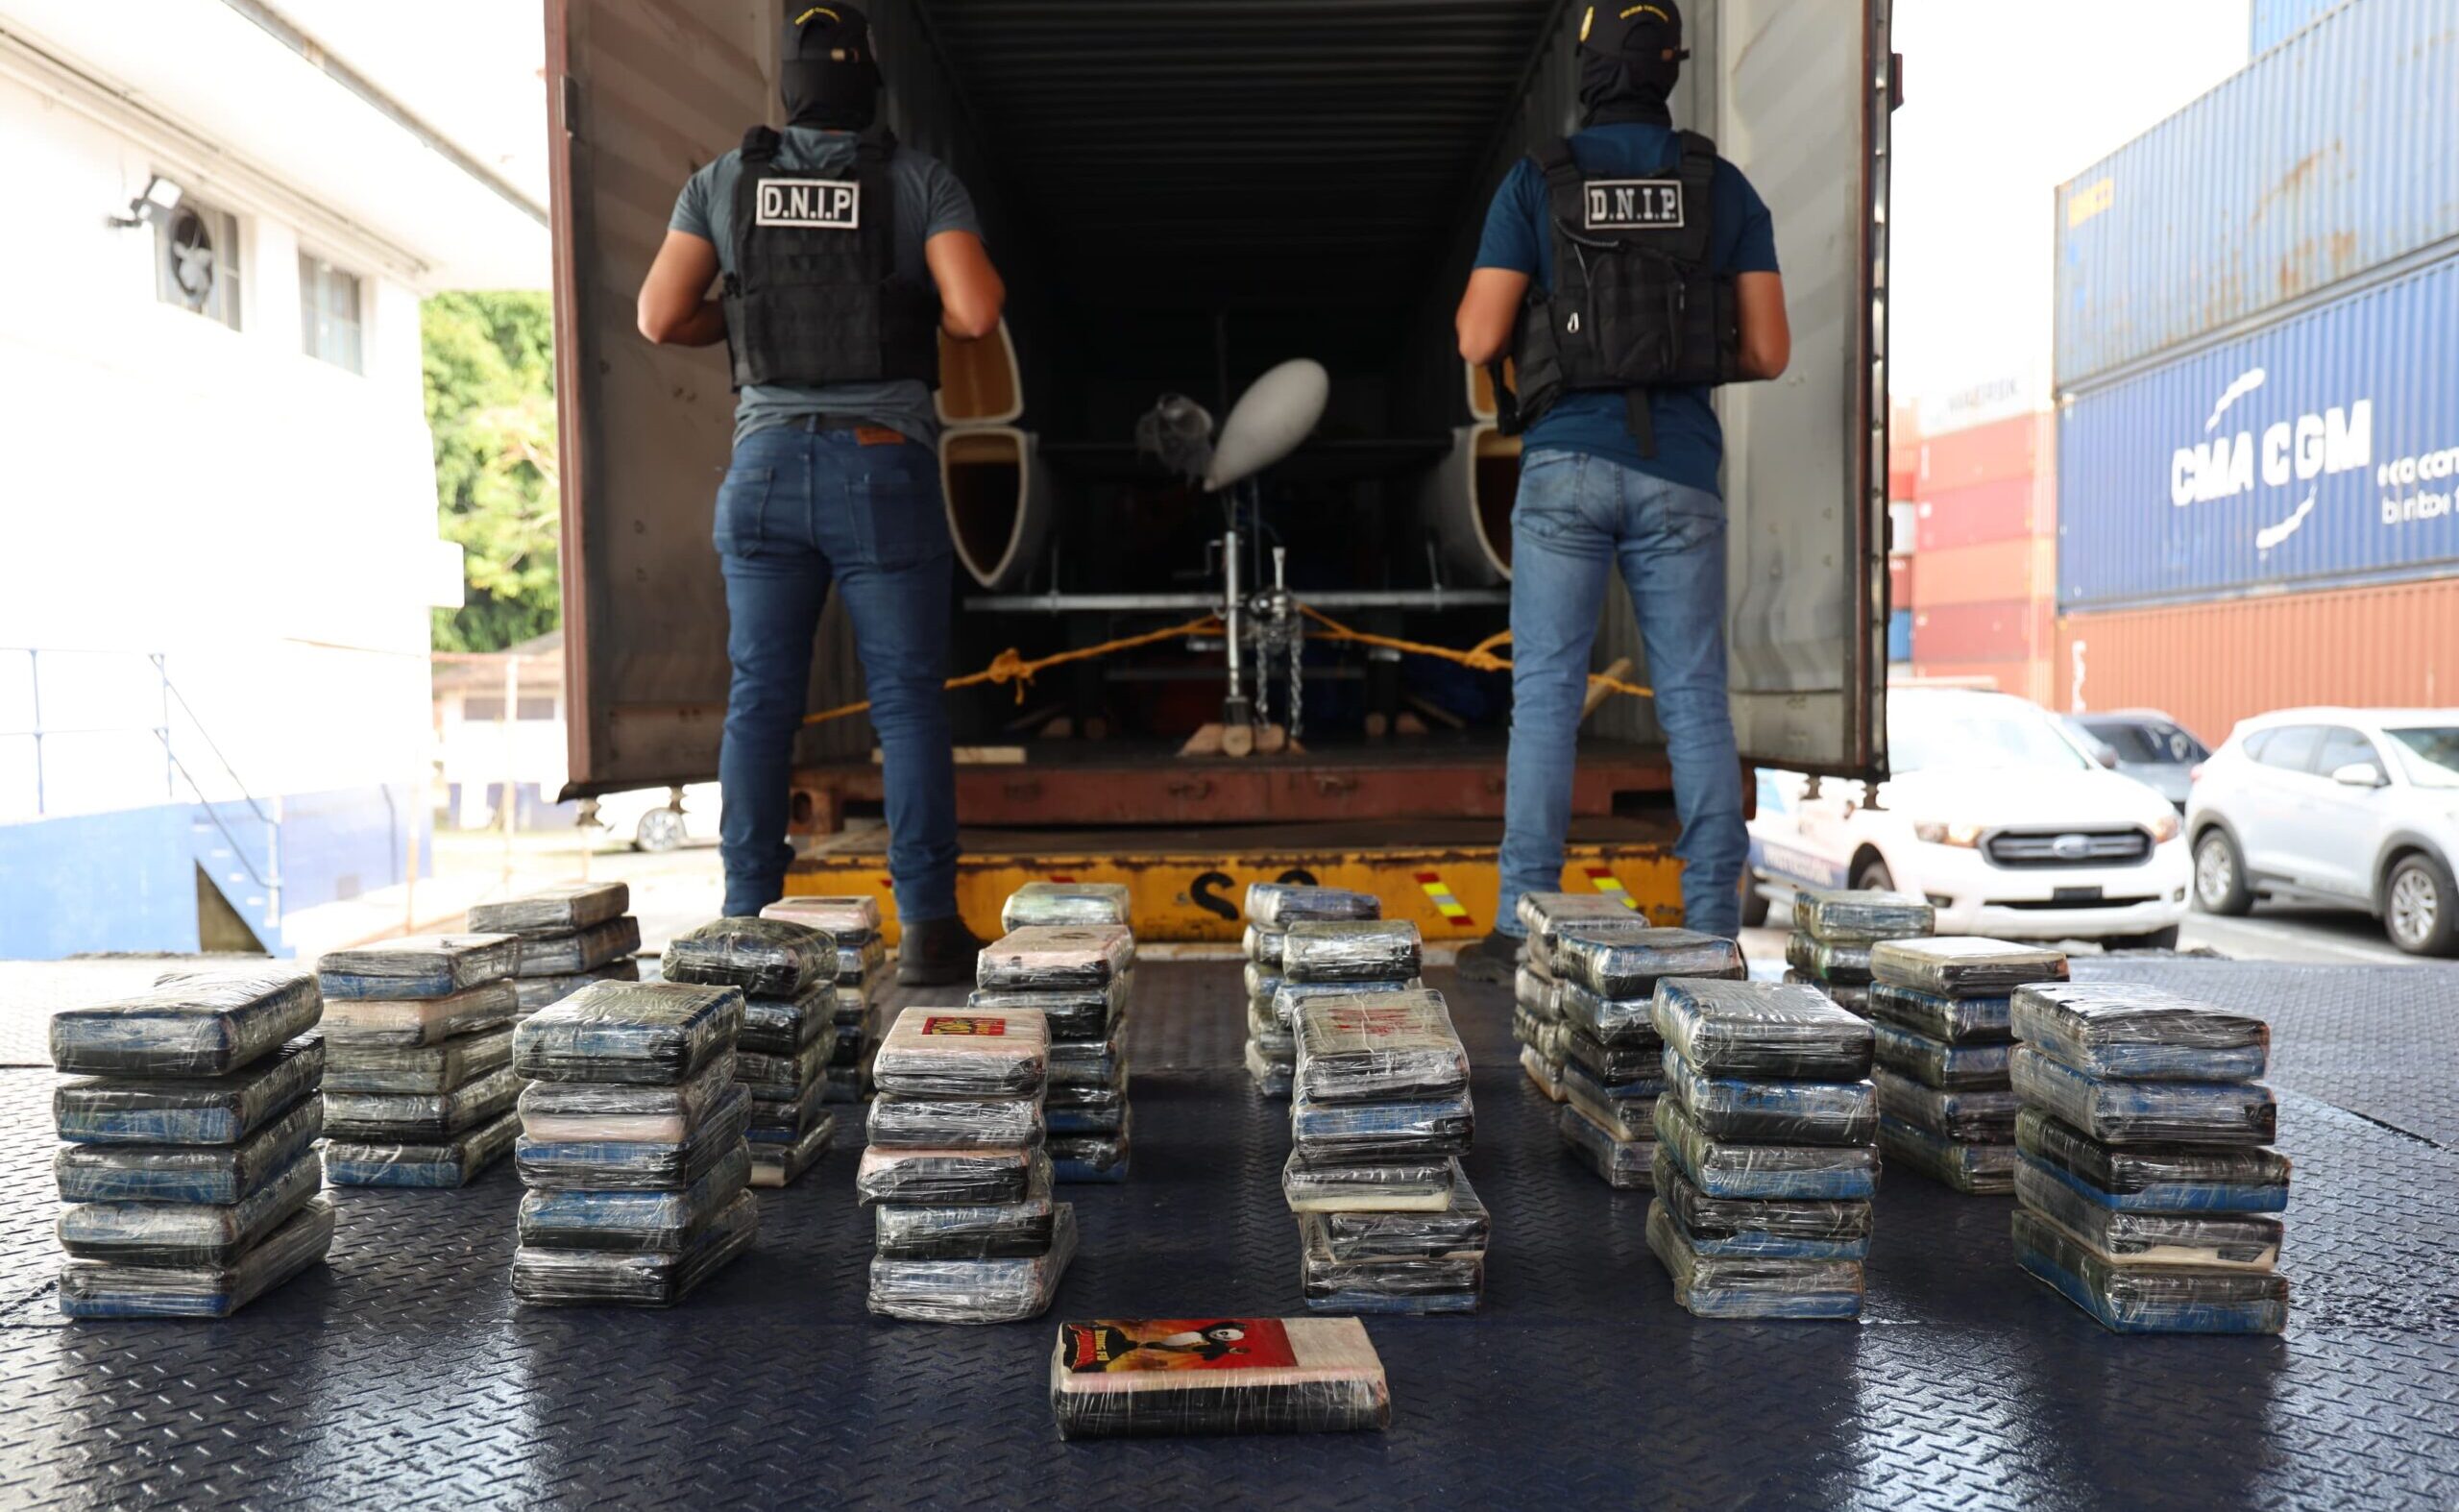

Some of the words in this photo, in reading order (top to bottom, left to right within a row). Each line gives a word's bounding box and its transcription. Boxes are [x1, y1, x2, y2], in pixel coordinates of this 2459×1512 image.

[764, 185, 852, 220] D.N.I.P
[2171, 430, 2255, 507] CMA
[2261, 398, 2372, 487] CGM
